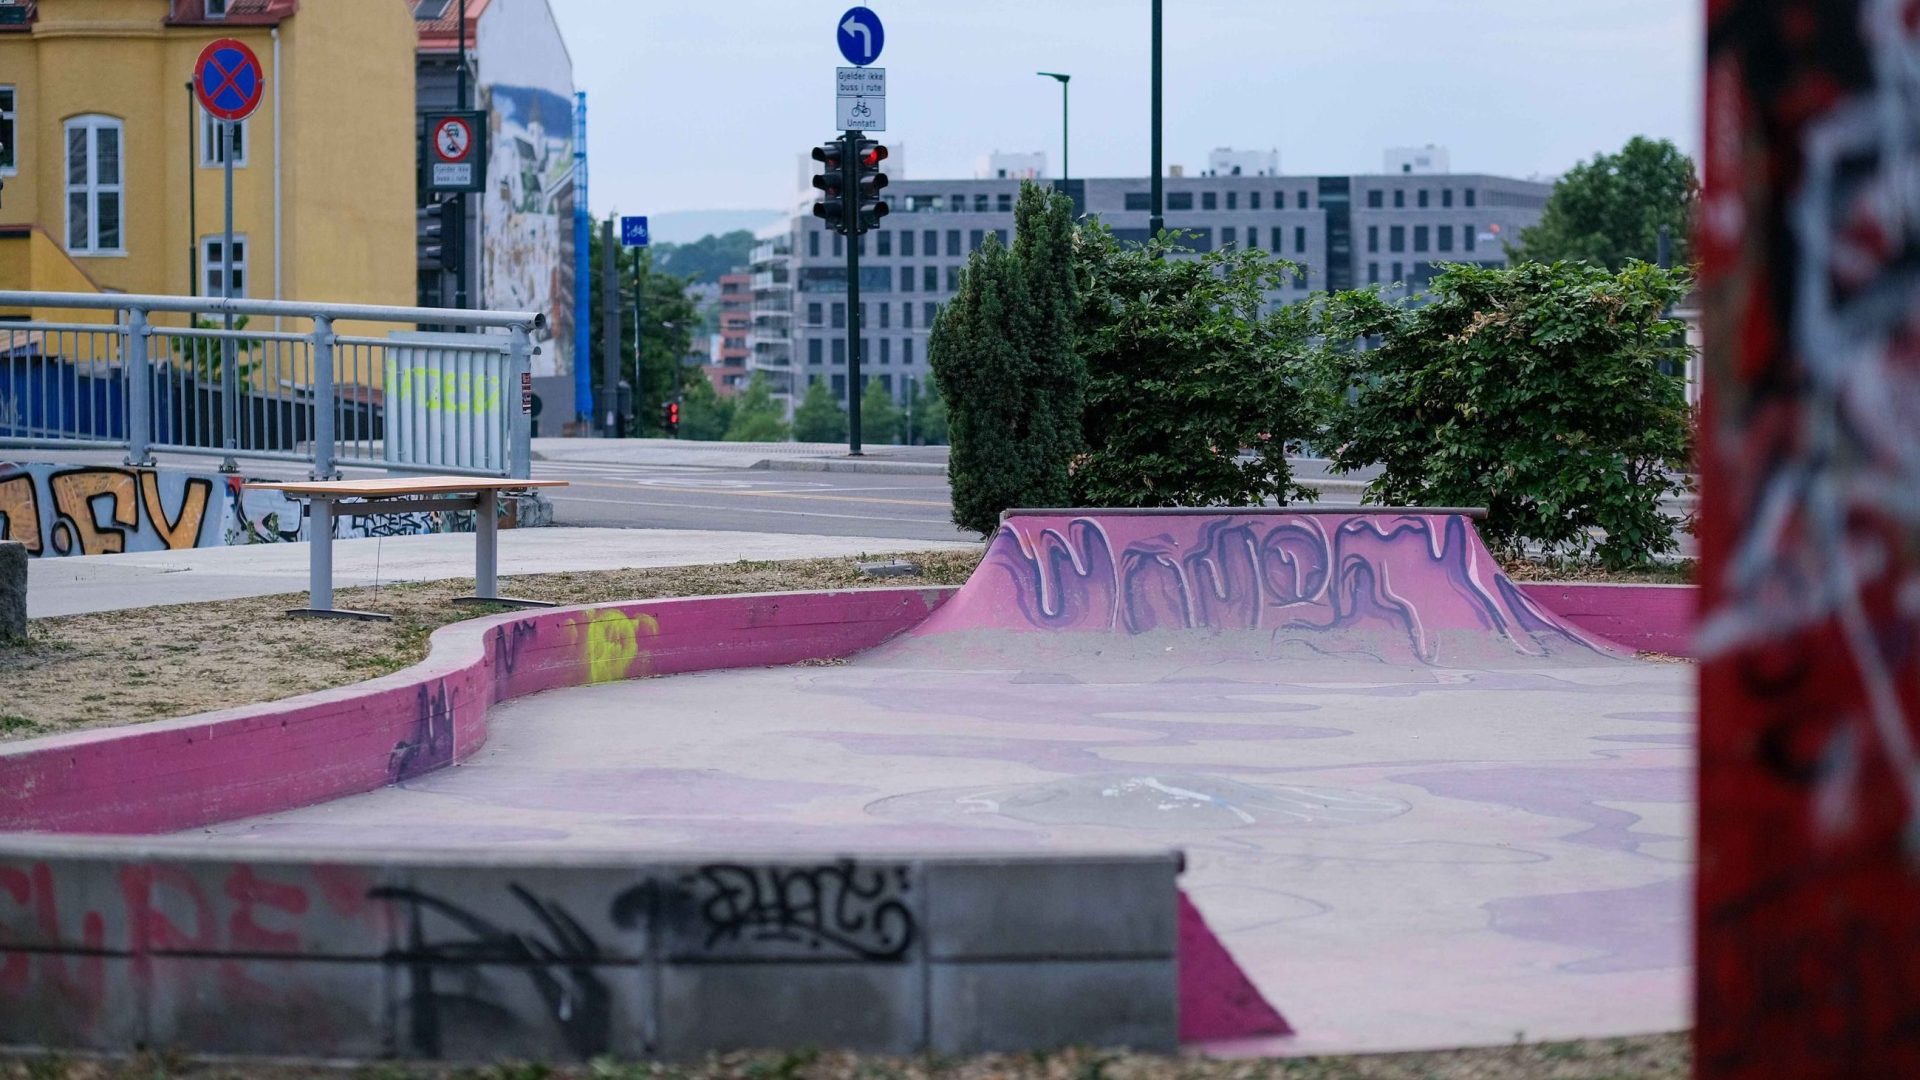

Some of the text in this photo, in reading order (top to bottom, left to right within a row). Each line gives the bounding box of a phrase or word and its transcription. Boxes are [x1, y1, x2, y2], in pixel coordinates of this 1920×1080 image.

[839, 71, 883, 82] Gjelder ikke
[840, 82, 858, 91] buss
[847, 119, 876, 128] Unntatt
